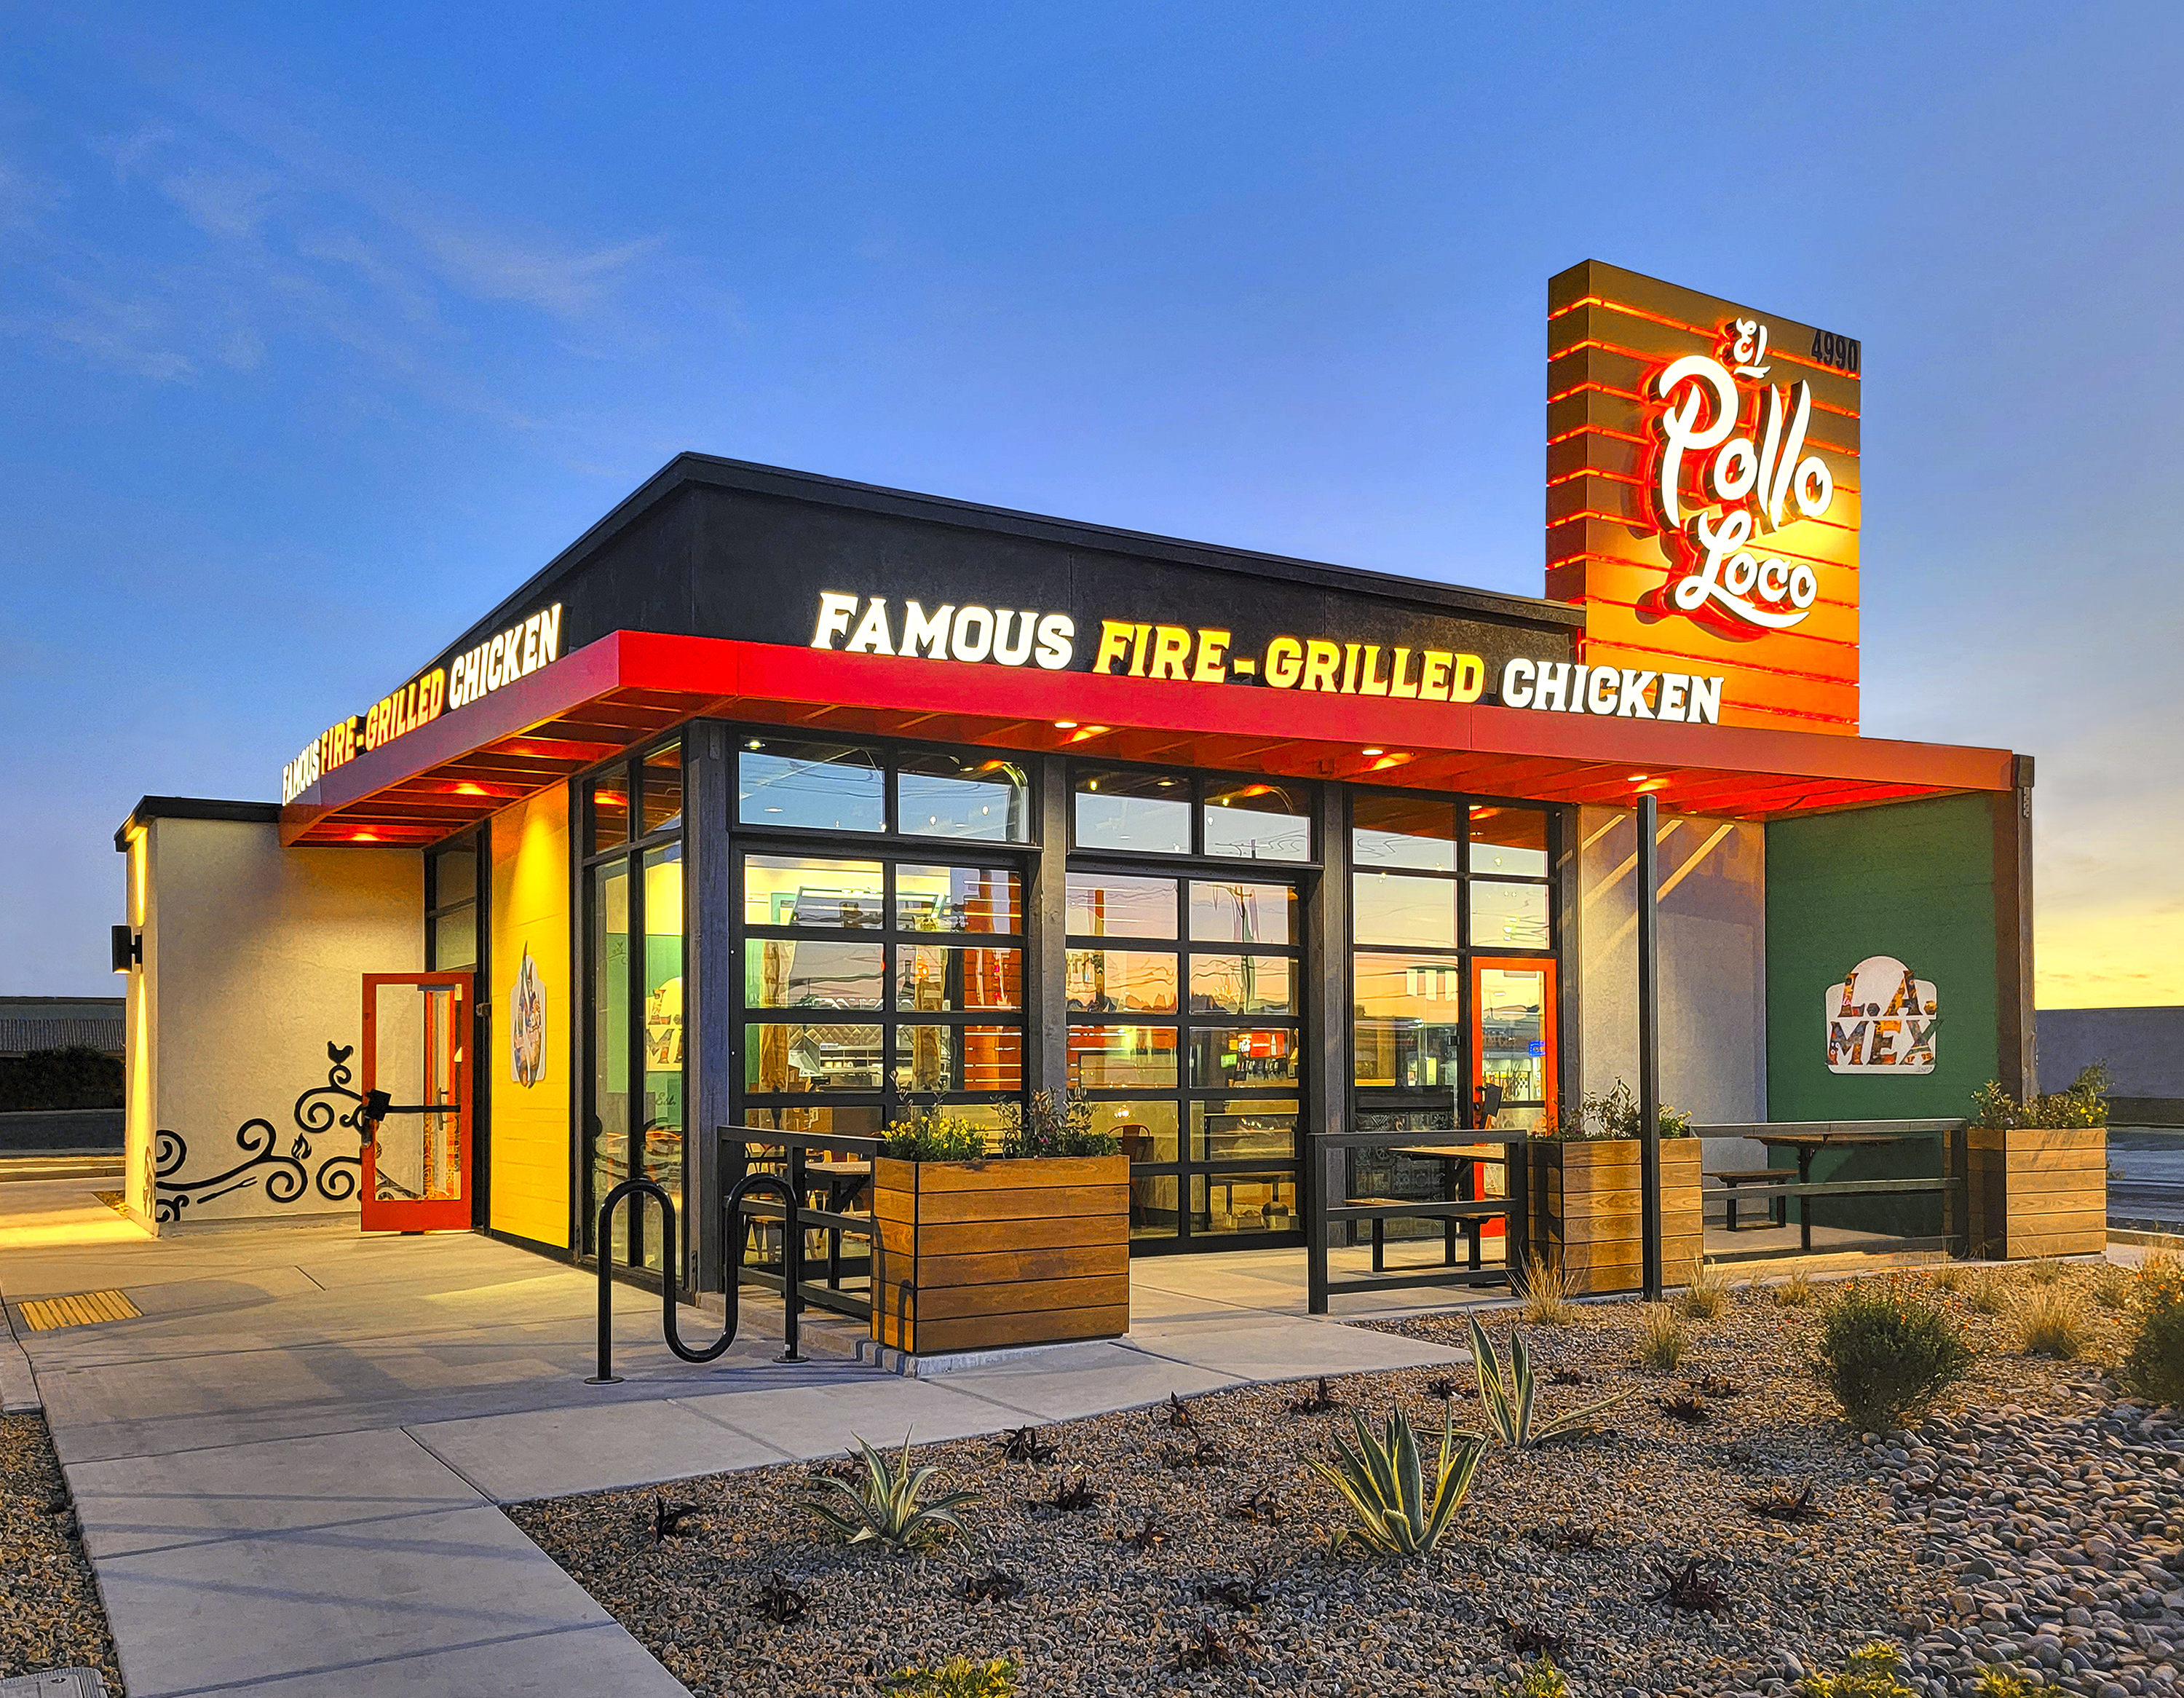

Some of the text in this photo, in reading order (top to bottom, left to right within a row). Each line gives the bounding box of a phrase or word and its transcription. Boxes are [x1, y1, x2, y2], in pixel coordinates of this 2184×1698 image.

[1733, 317, 1771, 379] El
[1811, 329, 1858, 372] 4990
[1658, 355, 1833, 532] Pollo
[1674, 510, 1818, 628] Loco
[810, 591, 1725, 724] FAMOUS FIRE-GRILLED CHICKEN
[282, 602, 563, 807] FAMOUS FIRE-GRILLED CHICKEN
[1837, 970, 1938, 1018] L.A.
[1826, 1019, 1943, 1065] MEX
